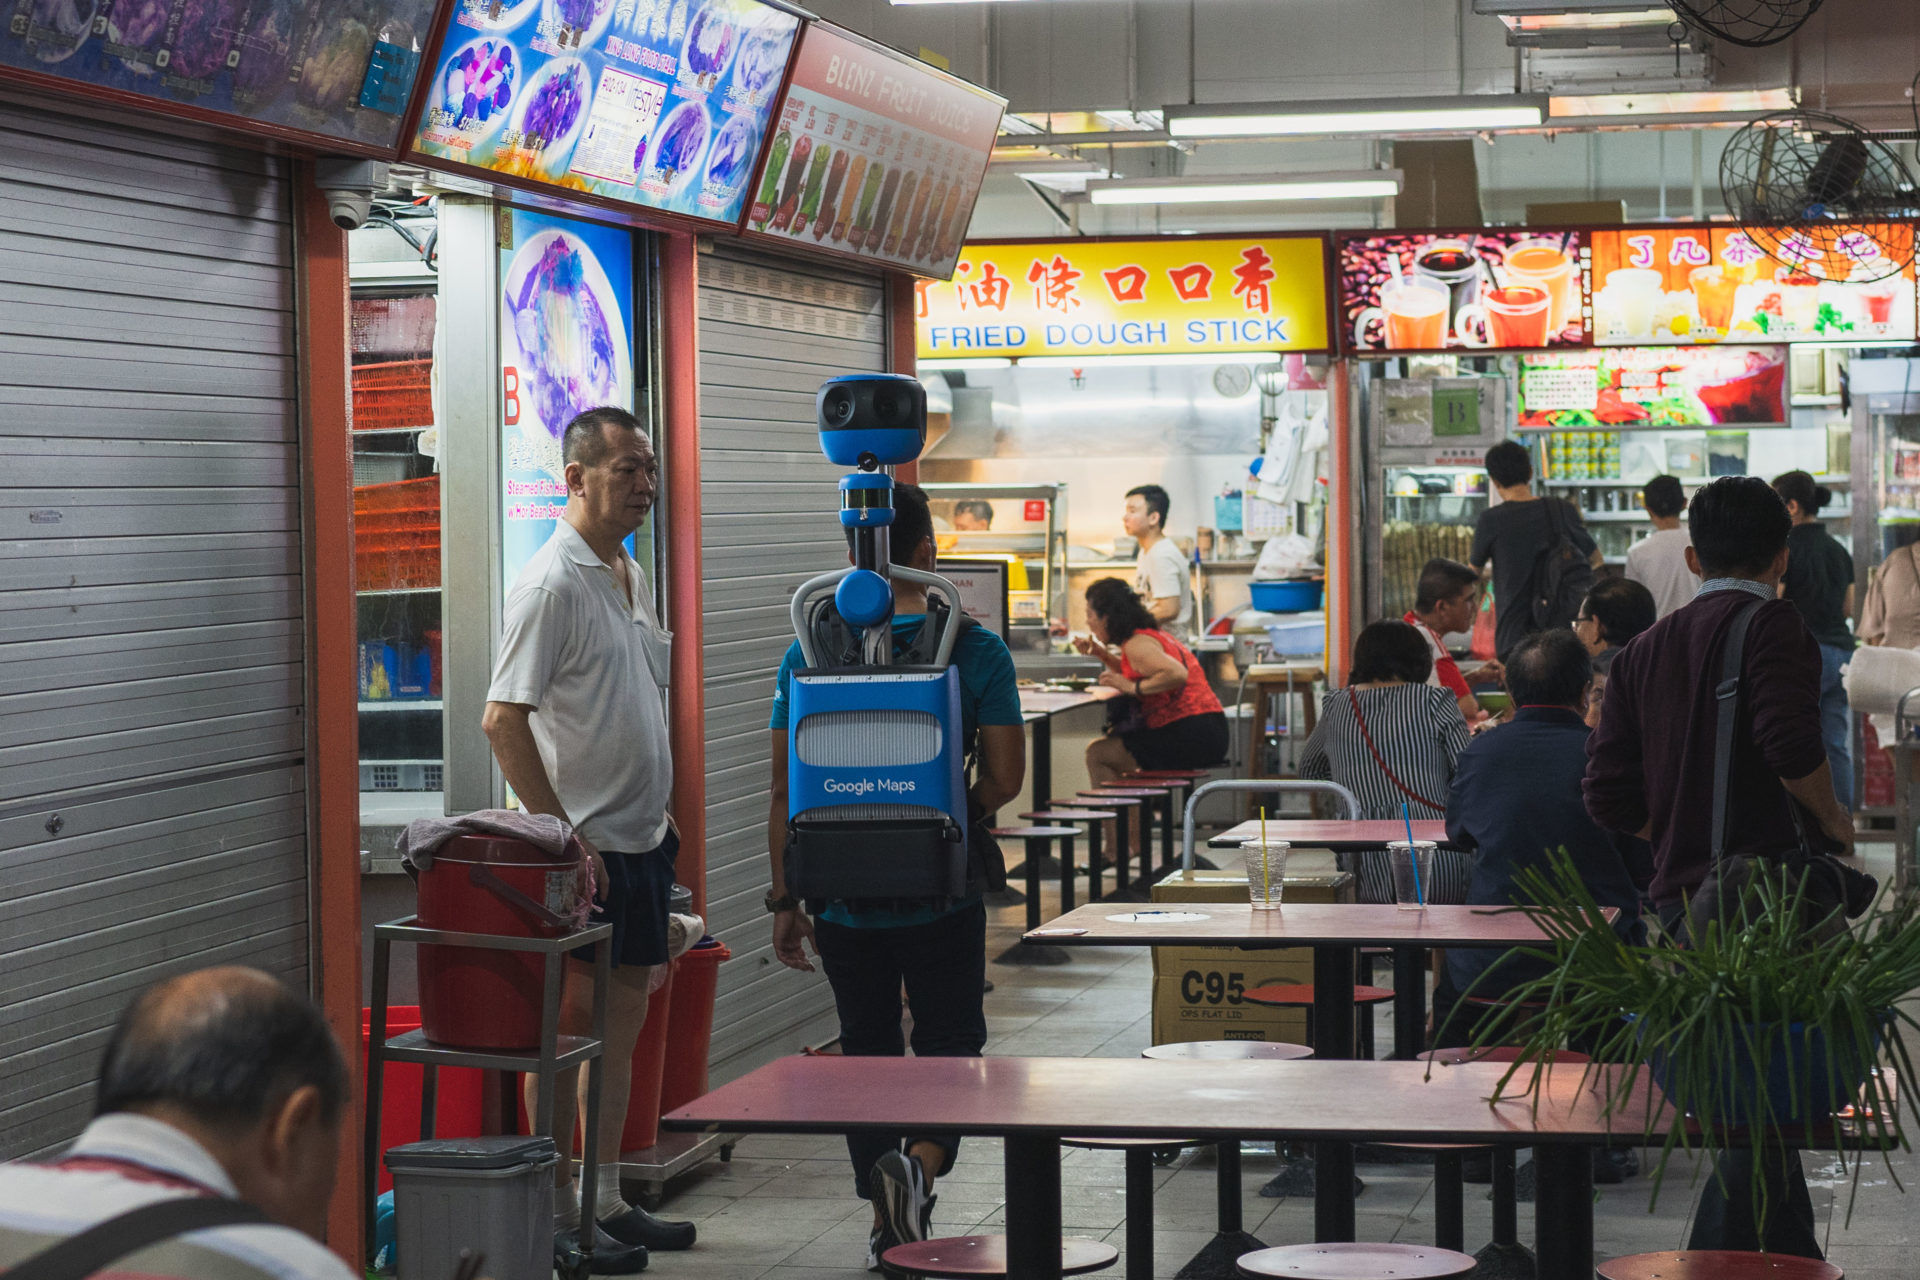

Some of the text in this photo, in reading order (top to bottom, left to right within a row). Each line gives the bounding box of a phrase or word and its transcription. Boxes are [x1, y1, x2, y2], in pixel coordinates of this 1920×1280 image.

[640, 47, 660, 69] FOOD
[826, 54, 873, 98] BLENZ
[878, 76, 928, 119] FRUIT
[931, 318, 1289, 349] FRIED DOUGH STICK
[504, 366, 521, 426] B
[507, 479, 568, 496] Steamed Fish Hea
[824, 778, 916, 796] Google Maps
[1181, 970, 1246, 1005] C95
[1181, 1009, 1243, 1019] OPS FLAT LID
